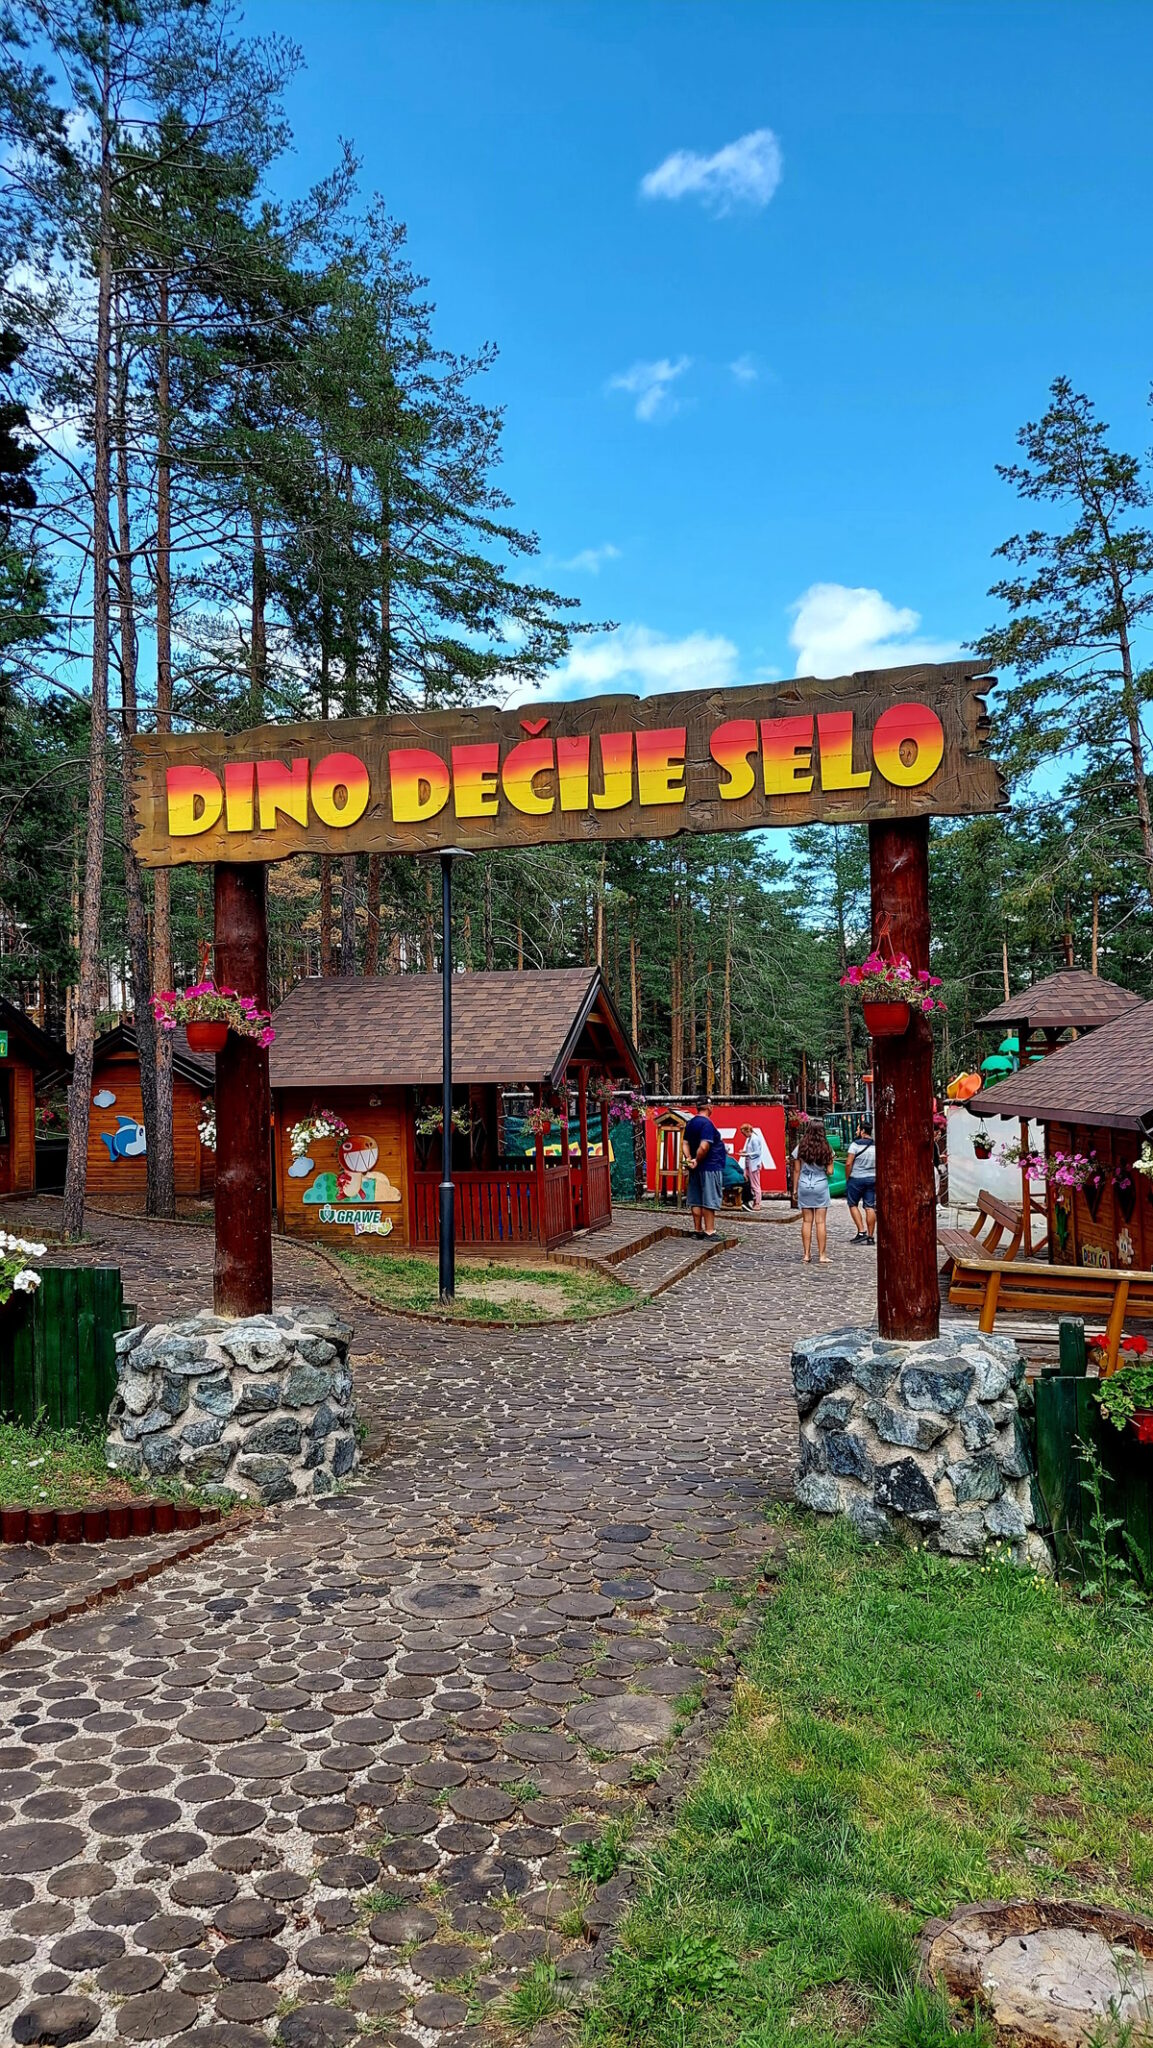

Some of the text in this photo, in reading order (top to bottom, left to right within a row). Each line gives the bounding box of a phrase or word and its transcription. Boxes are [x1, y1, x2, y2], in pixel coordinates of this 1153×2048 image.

[167, 702, 945, 837] DINO DEČIJE SELO
[336, 1210, 381, 1224] GRAWE
